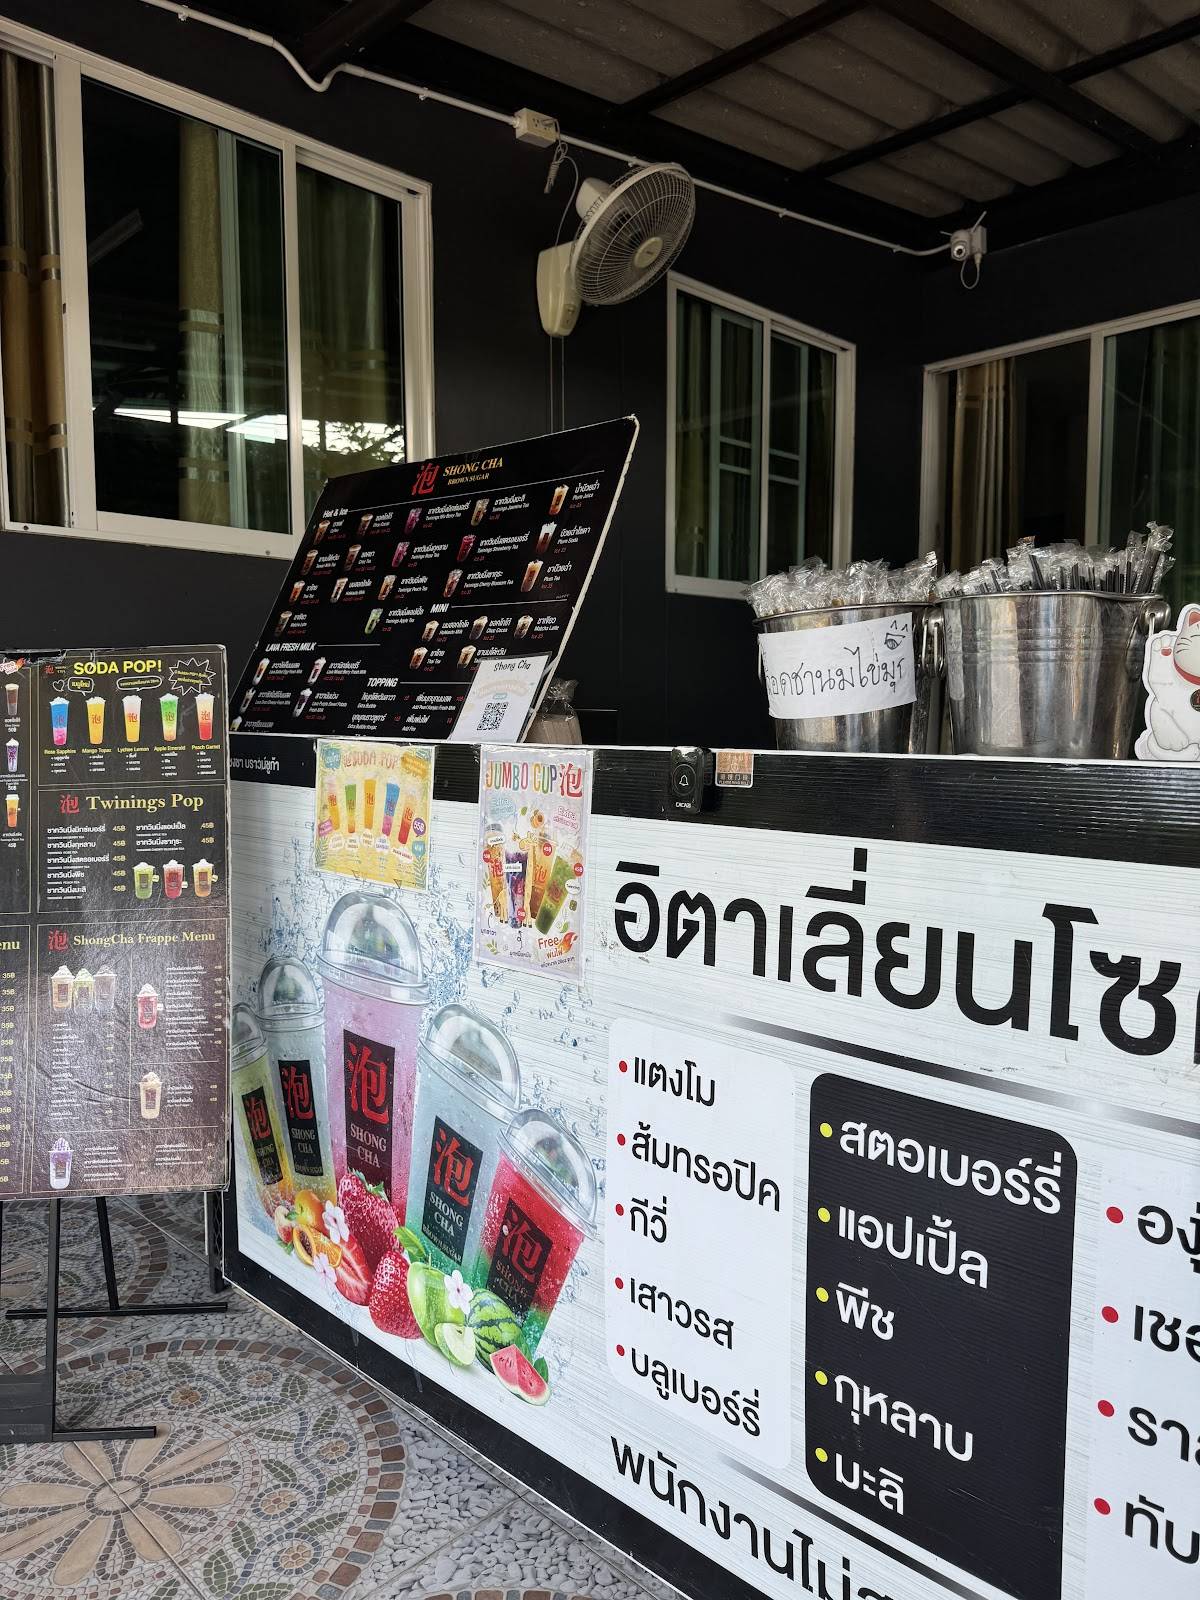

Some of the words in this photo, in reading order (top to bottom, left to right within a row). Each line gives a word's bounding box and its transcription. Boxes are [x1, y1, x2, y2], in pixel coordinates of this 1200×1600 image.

[412, 463, 439, 495] 泡
[443, 462, 480, 477] SHONG
[481, 457, 503, 471] CHA
[447, 477, 468, 486] BROWN
[468, 473, 490, 483] SUGAR
[323, 510, 333, 518] Hot
[430, 603, 449, 613] MINI
[265, 643, 281, 652] LAVA
[280, 643, 300, 652] FRESH
[300, 642, 317, 651] MILK
[73, 660, 119, 676] SODA
[123, 660, 163, 674] POP!
[367, 678, 399, 688] TOPPING
[485, 760, 529, 790] JUMBO
[532, 763, 557, 794] CUP
[558, 762, 584, 798] 泡
[59, 793, 80, 814] 泡
[86, 796, 166, 813] Twinings
[171, 793, 204, 813] Pop
[73, 934, 134, 946] ShongCha
[138, 933, 178, 944] Frappe
[182, 931, 215, 942] Menu
[537, 936, 559, 949] Free
[613, 846, 1200, 1065] อิตาเลี่ยนโซ
[282, 1065, 315, 1121] 泡
[347, 1042, 390, 1125] 泡
[633, 1057, 716, 1107] แตงโม
[291, 1127, 316, 1141] SHONG
[297, 1141, 313, 1154] CHA
[350, 1124, 387, 1153] SHONG
[357, 1146, 381, 1169] CHA
[433, 1127, 474, 1208] 泡
[631, 1121, 781, 1212] ส้มทรอปิค
[839, 1120, 1062, 1215] สตอเบอร์รี่
[429, 1191, 465, 1228] SHONG
[433, 1211, 455, 1238] CHA
[629, 1196, 669, 1244] กีวี่
[838, 1205, 988, 1289] แอปเปิ้ล
[495, 1261, 529, 1298] SHONG
[630, 1277, 734, 1350] เสาวรส
[836, 1282, 895, 1341] พีช
[631, 1346, 761, 1437] บลูเบอร์รี่
[835, 1374, 974, 1462] กุหลาบ
[1127, 1406, 1200, 1467] รา
[835, 1452, 904, 1515] มะลิ
